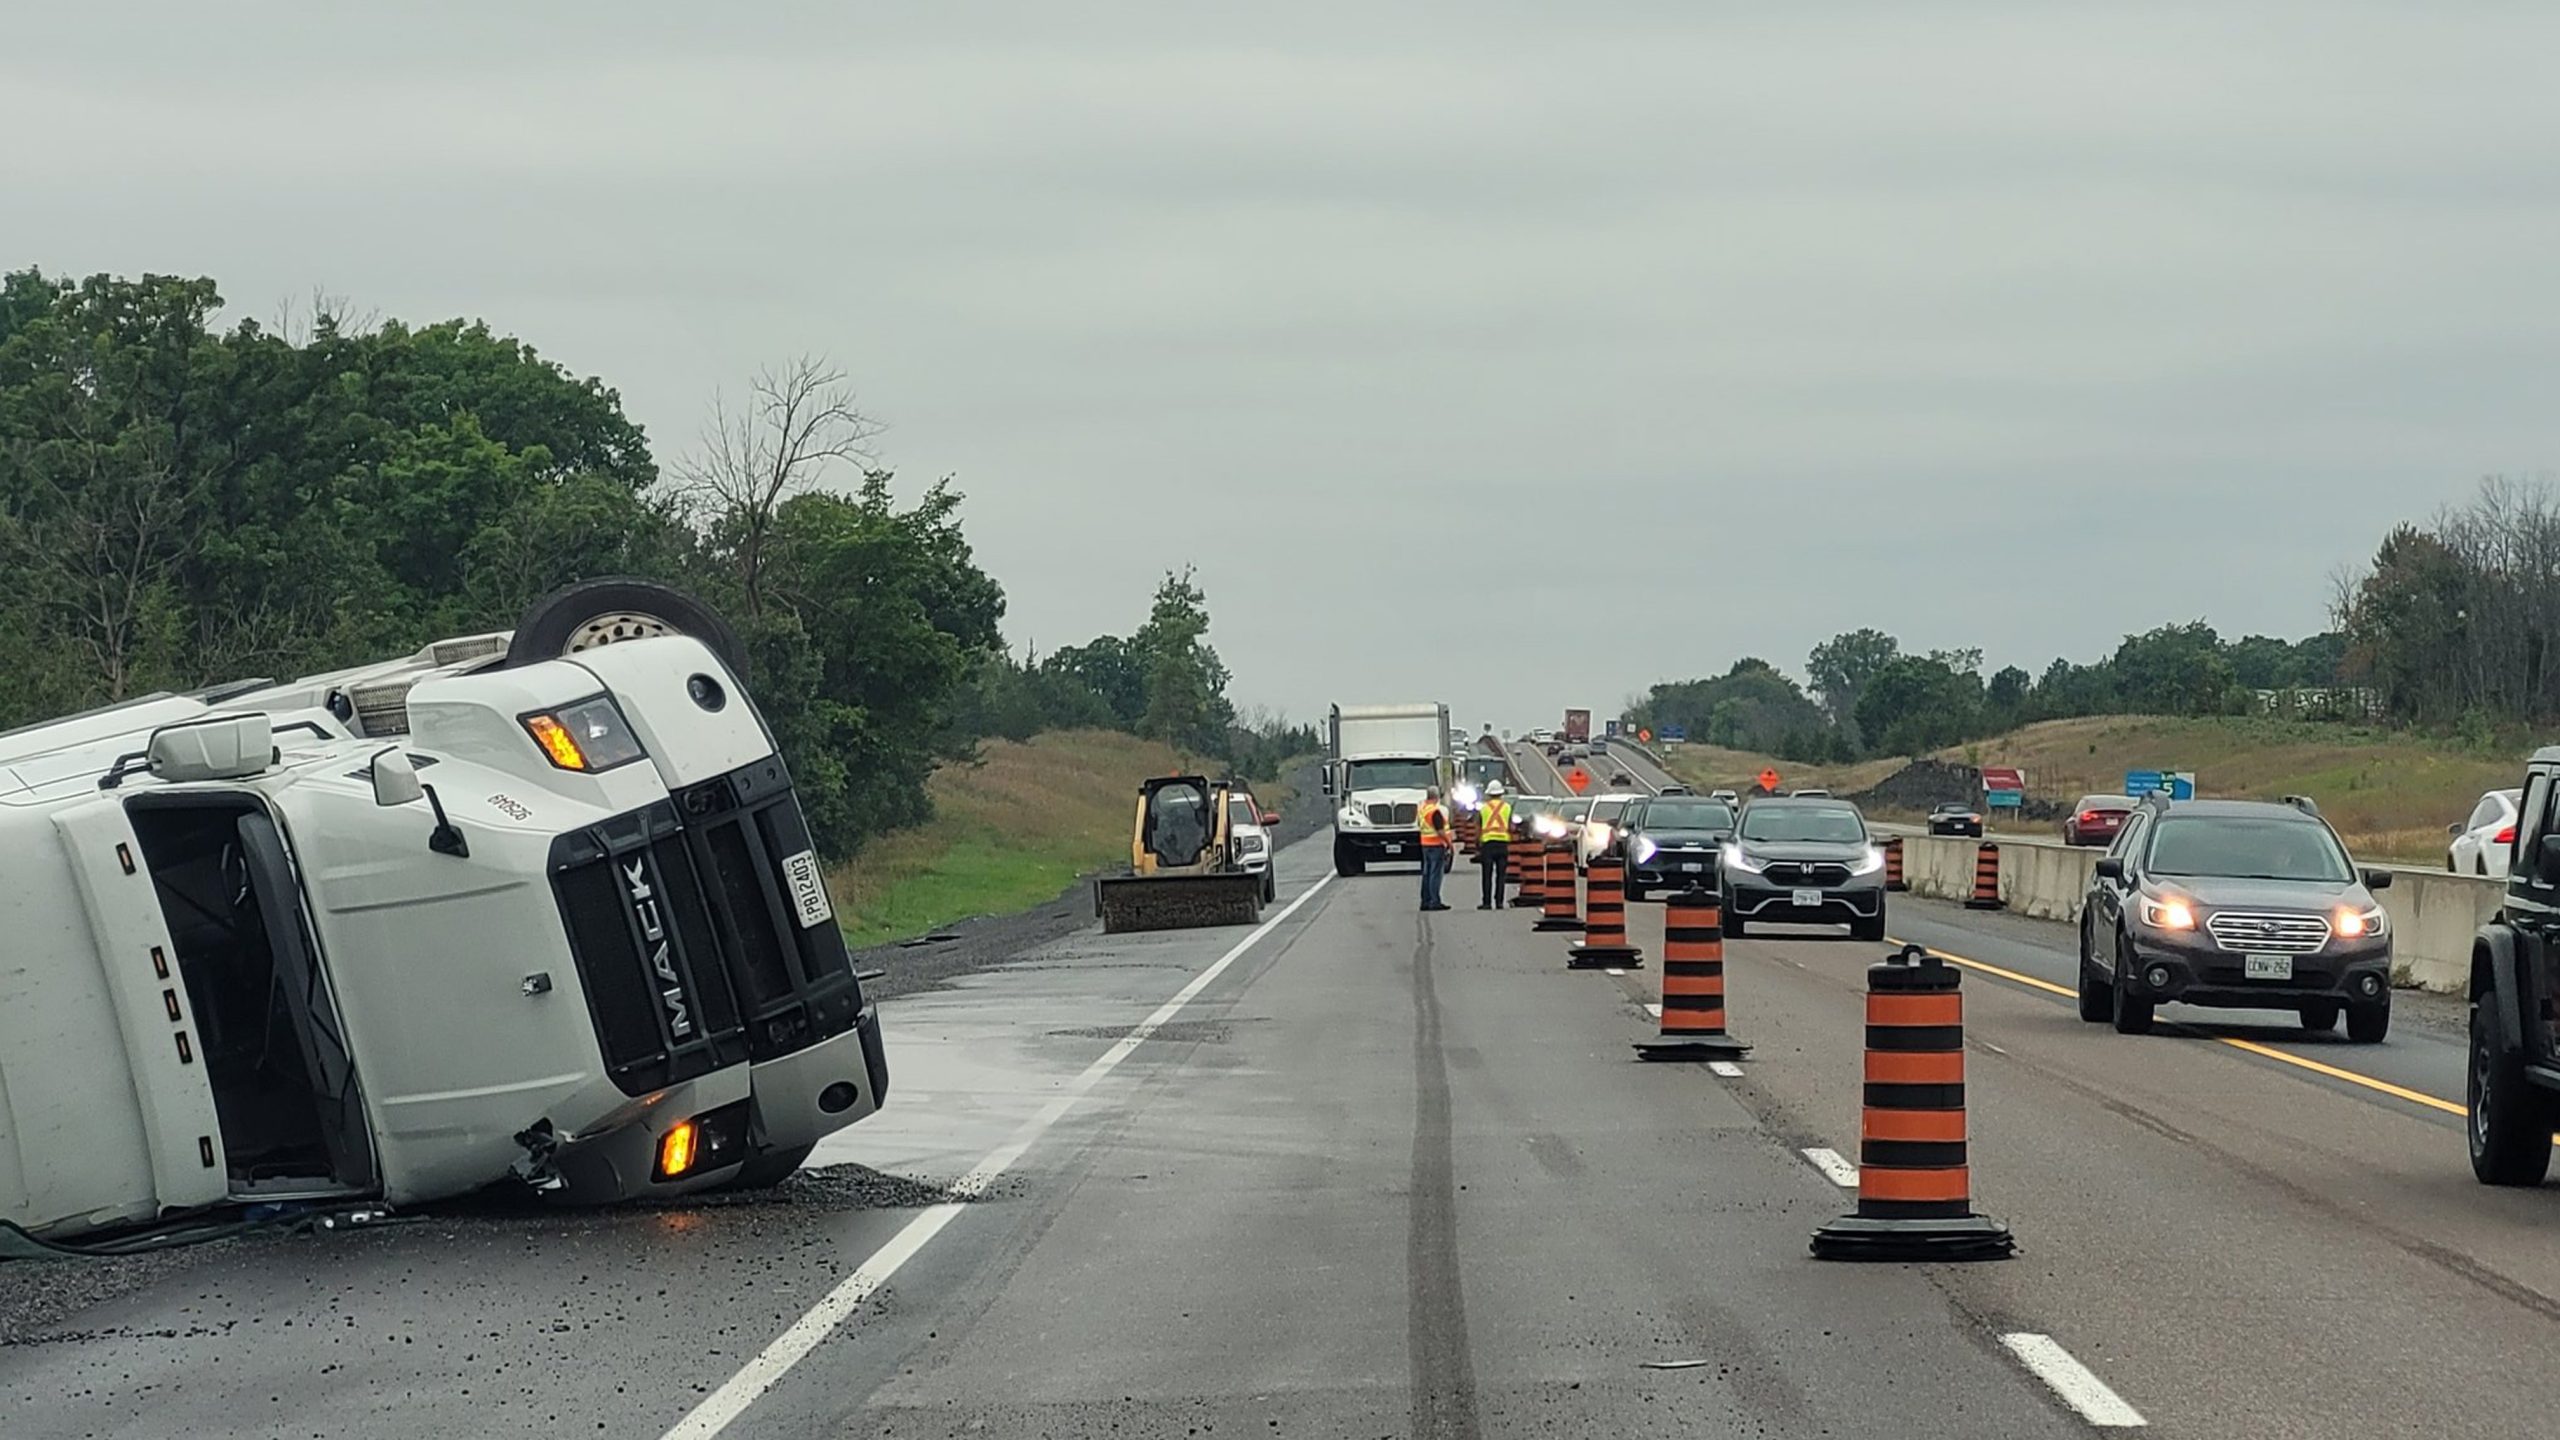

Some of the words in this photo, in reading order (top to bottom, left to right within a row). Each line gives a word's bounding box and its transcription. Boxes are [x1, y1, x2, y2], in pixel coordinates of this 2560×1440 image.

[2163, 782, 2174, 795] 5
[791, 857, 821, 915] PB12403
[623, 857, 691, 1037] MACK
